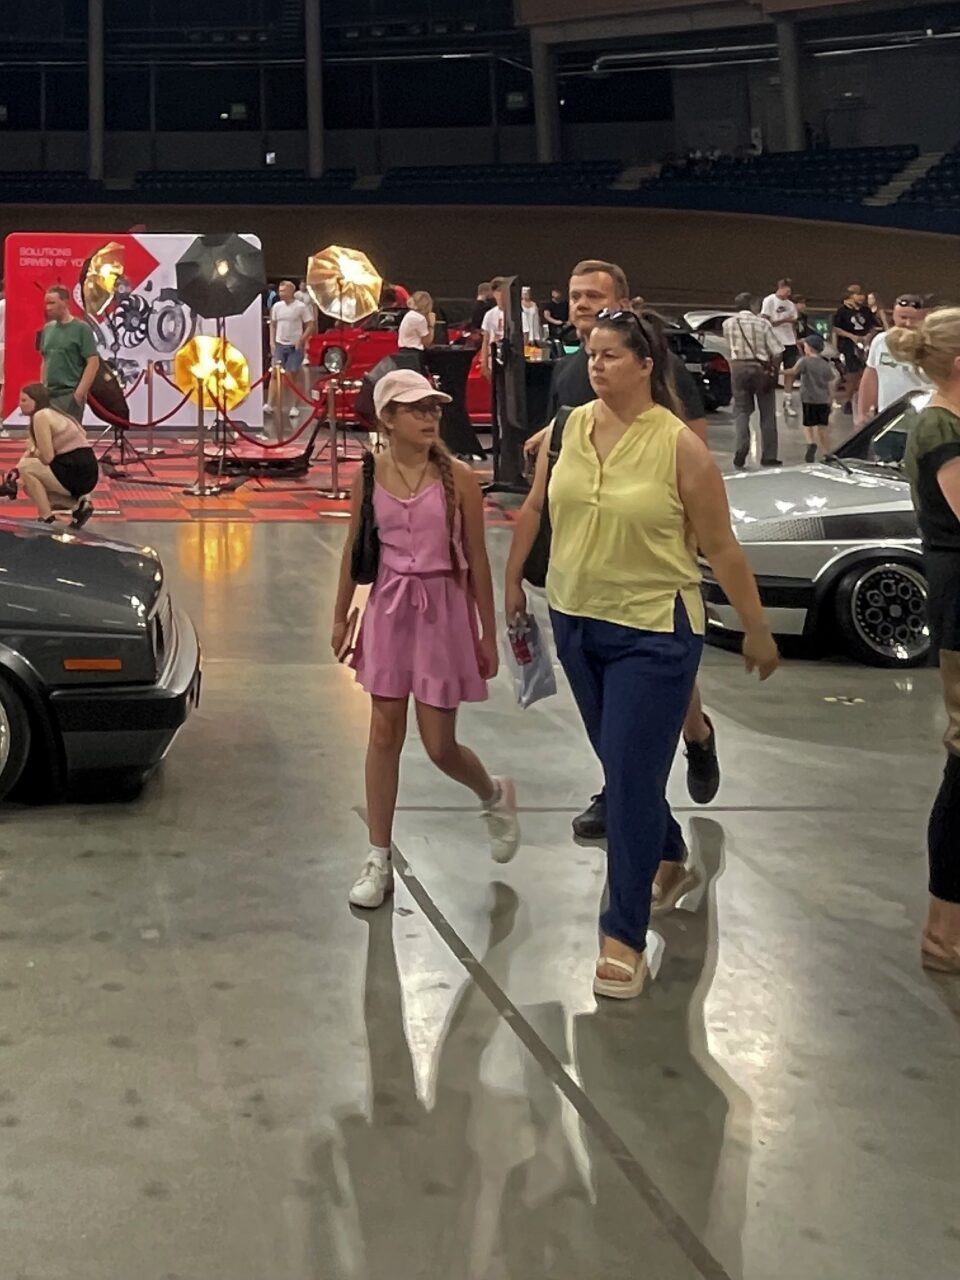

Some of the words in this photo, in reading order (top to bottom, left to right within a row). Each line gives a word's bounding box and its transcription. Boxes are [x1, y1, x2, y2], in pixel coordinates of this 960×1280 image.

[19, 247, 72, 257] SOLUTIONS
[19, 258, 53, 267] DRIVEN
[55, 258, 67, 267] BY
[71, 258, 85, 267] YO
